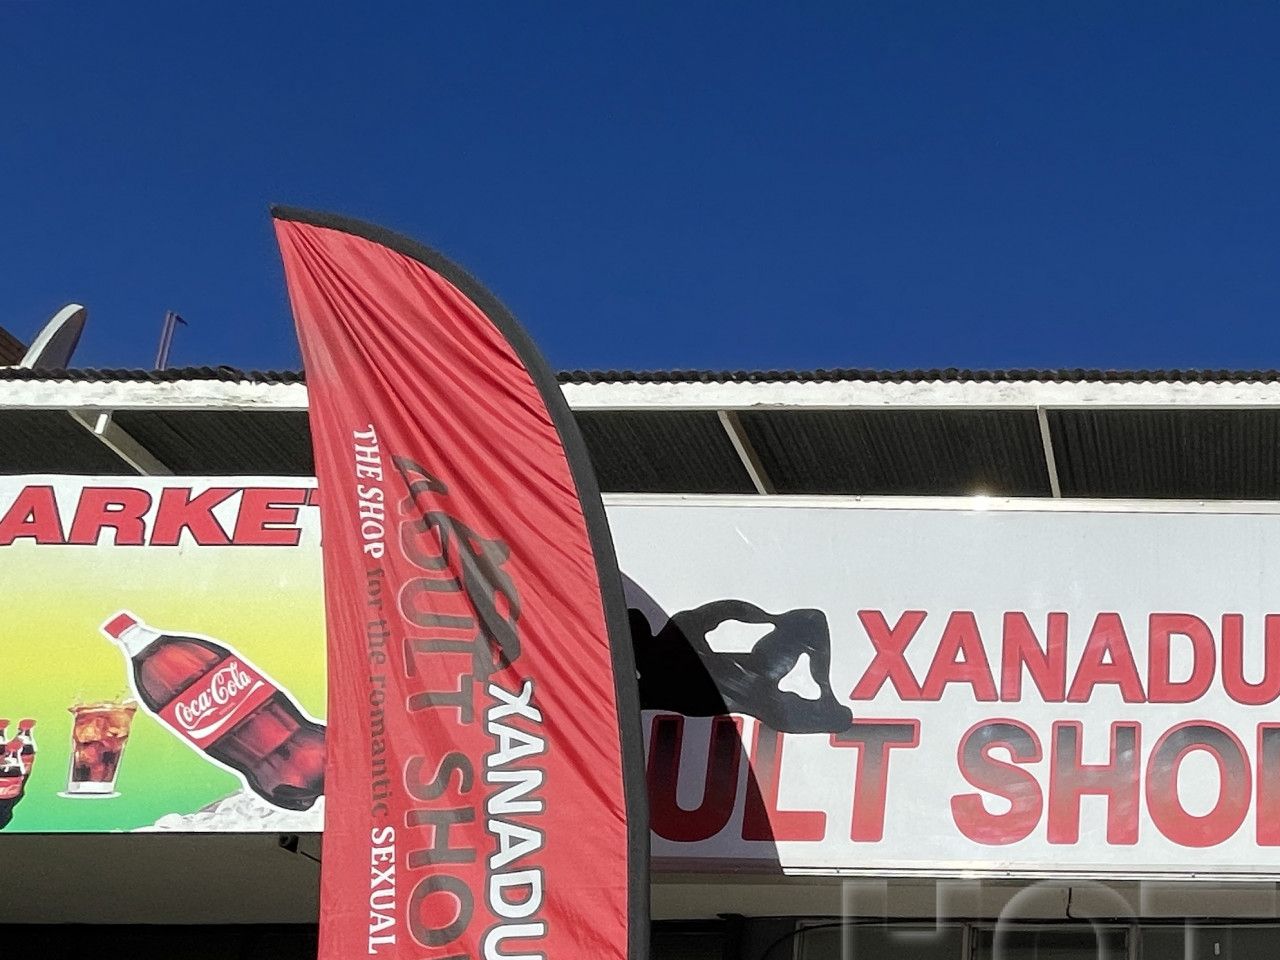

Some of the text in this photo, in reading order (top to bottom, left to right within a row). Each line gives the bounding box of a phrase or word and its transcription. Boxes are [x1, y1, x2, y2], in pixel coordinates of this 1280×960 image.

[353, 423, 383, 482] THE
[357, 484, 386, 559] SHOP
[366, 567, 386, 607] for
[367, 619, 390, 666] the
[368, 674, 391, 818] romantic
[368, 826, 396, 955] SEXUAL
